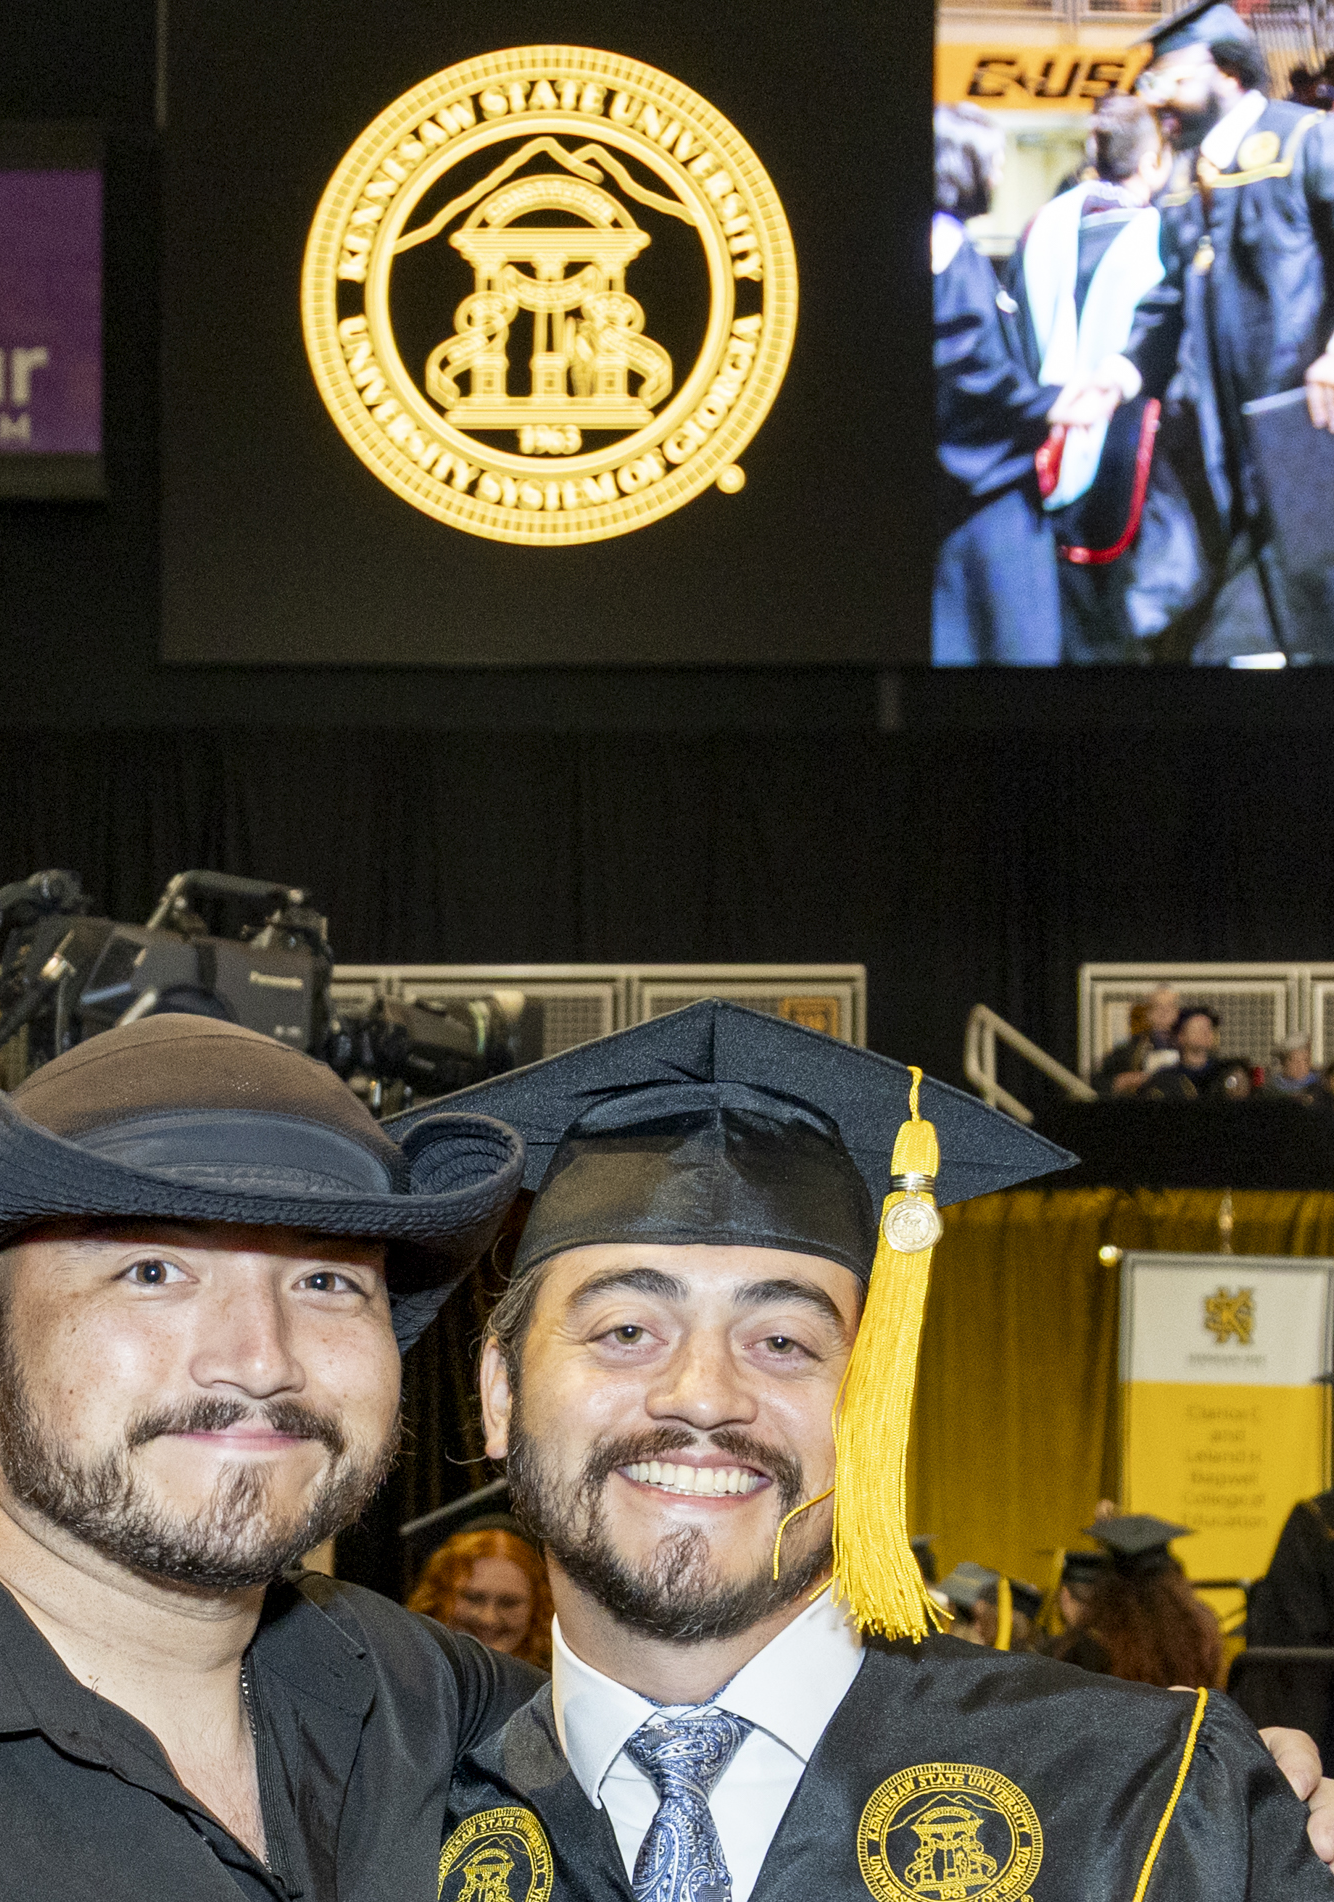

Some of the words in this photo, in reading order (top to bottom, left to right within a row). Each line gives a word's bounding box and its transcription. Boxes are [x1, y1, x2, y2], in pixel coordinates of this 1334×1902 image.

[337, 96, 478, 282] KENNESAW
[479, 79, 608, 116] STATE
[609, 88, 764, 283] UNIVERSITY
[338, 315, 479, 494] UNIVERSITY
[617, 446, 668, 491] OF
[868, 1779, 915, 1841] KENNESAW
[918, 1773, 964, 1786] STATE
[968, 1775, 1031, 1834] UNIVERSITY
[480, 1817, 514, 1831] STATE
[516, 1819, 547, 1874] UNIVERSITY
[999, 1846, 1032, 1895] GEORGIA
[940, 1887, 966, 1899] 1963
